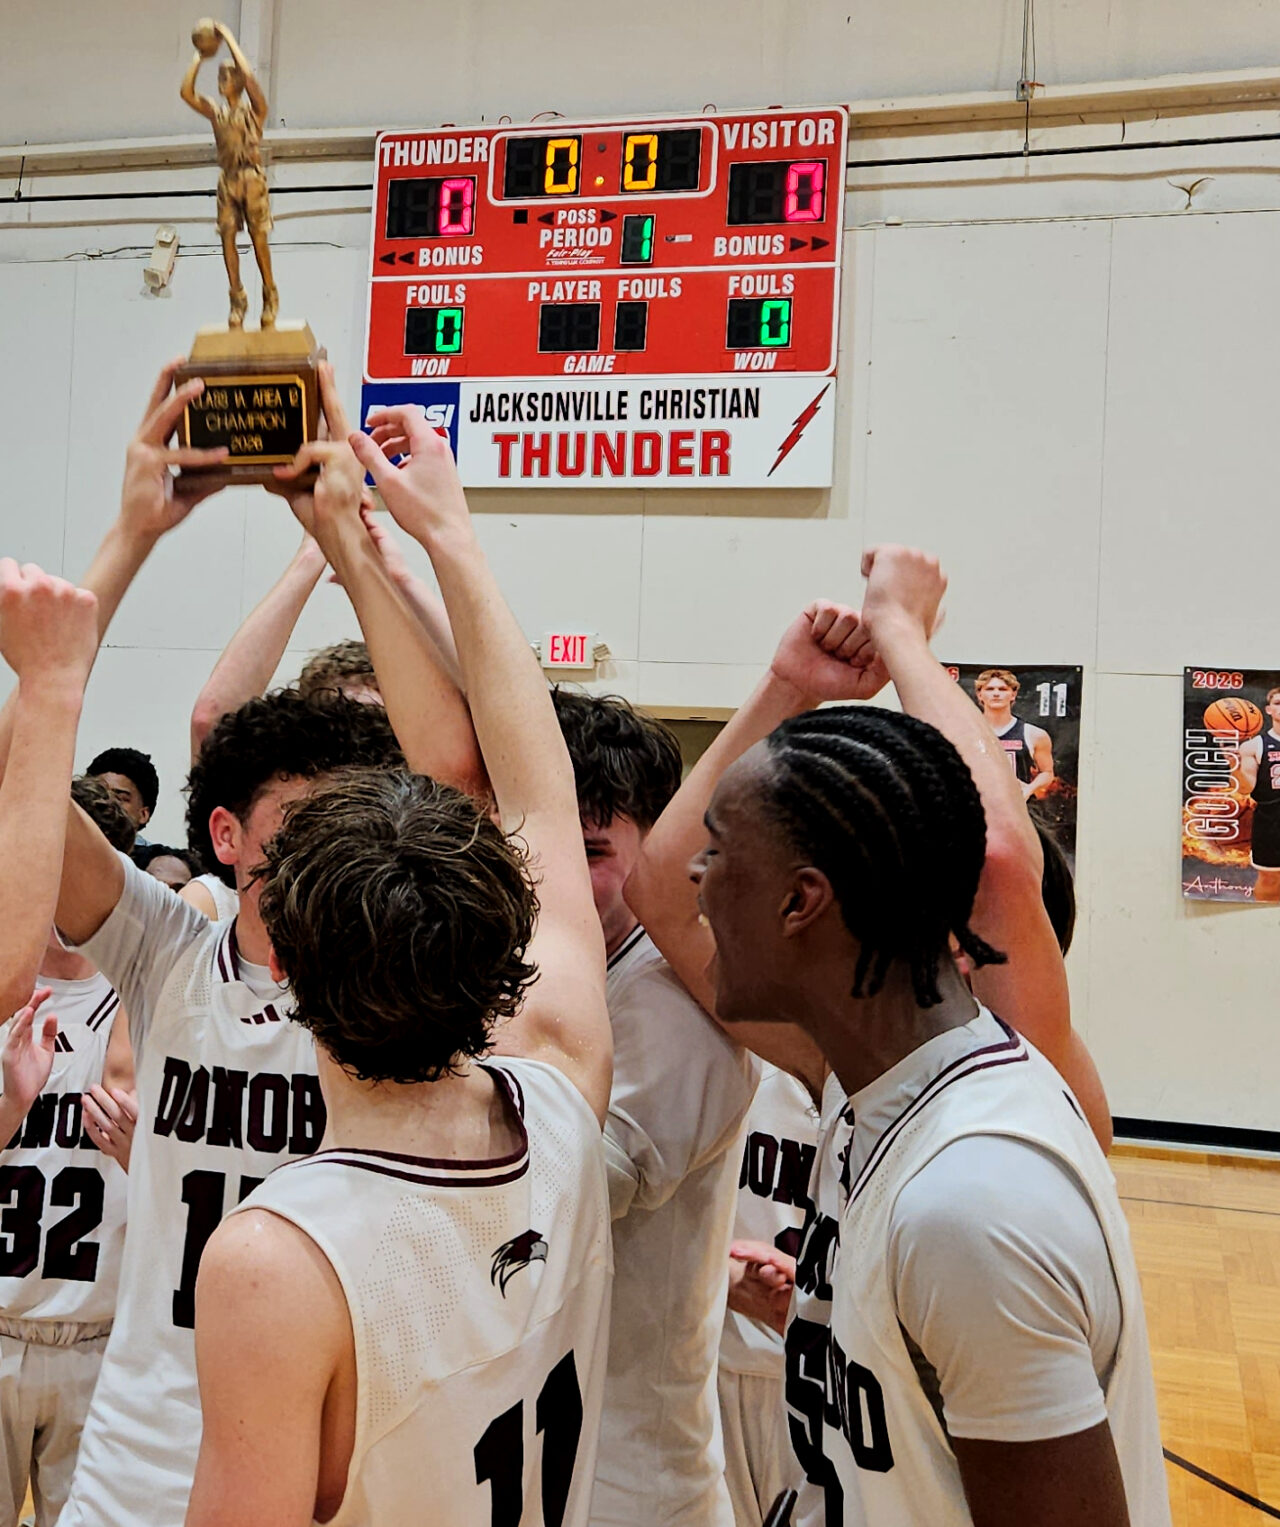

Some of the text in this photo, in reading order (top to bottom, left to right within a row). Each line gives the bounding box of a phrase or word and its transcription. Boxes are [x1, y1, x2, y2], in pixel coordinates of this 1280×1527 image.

[722, 118, 835, 150] VISITOR
[380, 137, 489, 167] THUNDER
[557, 208, 597, 225] POSS
[539, 226, 613, 249] PERIOD
[713, 234, 786, 257] BONUS
[418, 245, 484, 267] BONUS
[406, 283, 467, 305] FOULS
[527, 277, 683, 302] PLAYER FOULS
[728, 273, 796, 296] FOULS
[410, 358, 451, 377] WON
[563, 354, 617, 374] GAME
[733, 351, 778, 371] WON
[469, 387, 761, 423] JACKSONVILLE CHRISTIAN
[205, 410, 287, 432] CHAMPION
[491, 429, 733, 479] THUNDER
[549, 634, 588, 663] EXIT
[1191, 671, 1244, 690] 2026
[1035, 682, 1068, 718] 11
[1184, 728, 1241, 841] GOOCH
[474, 1348, 584, 1527] 11
